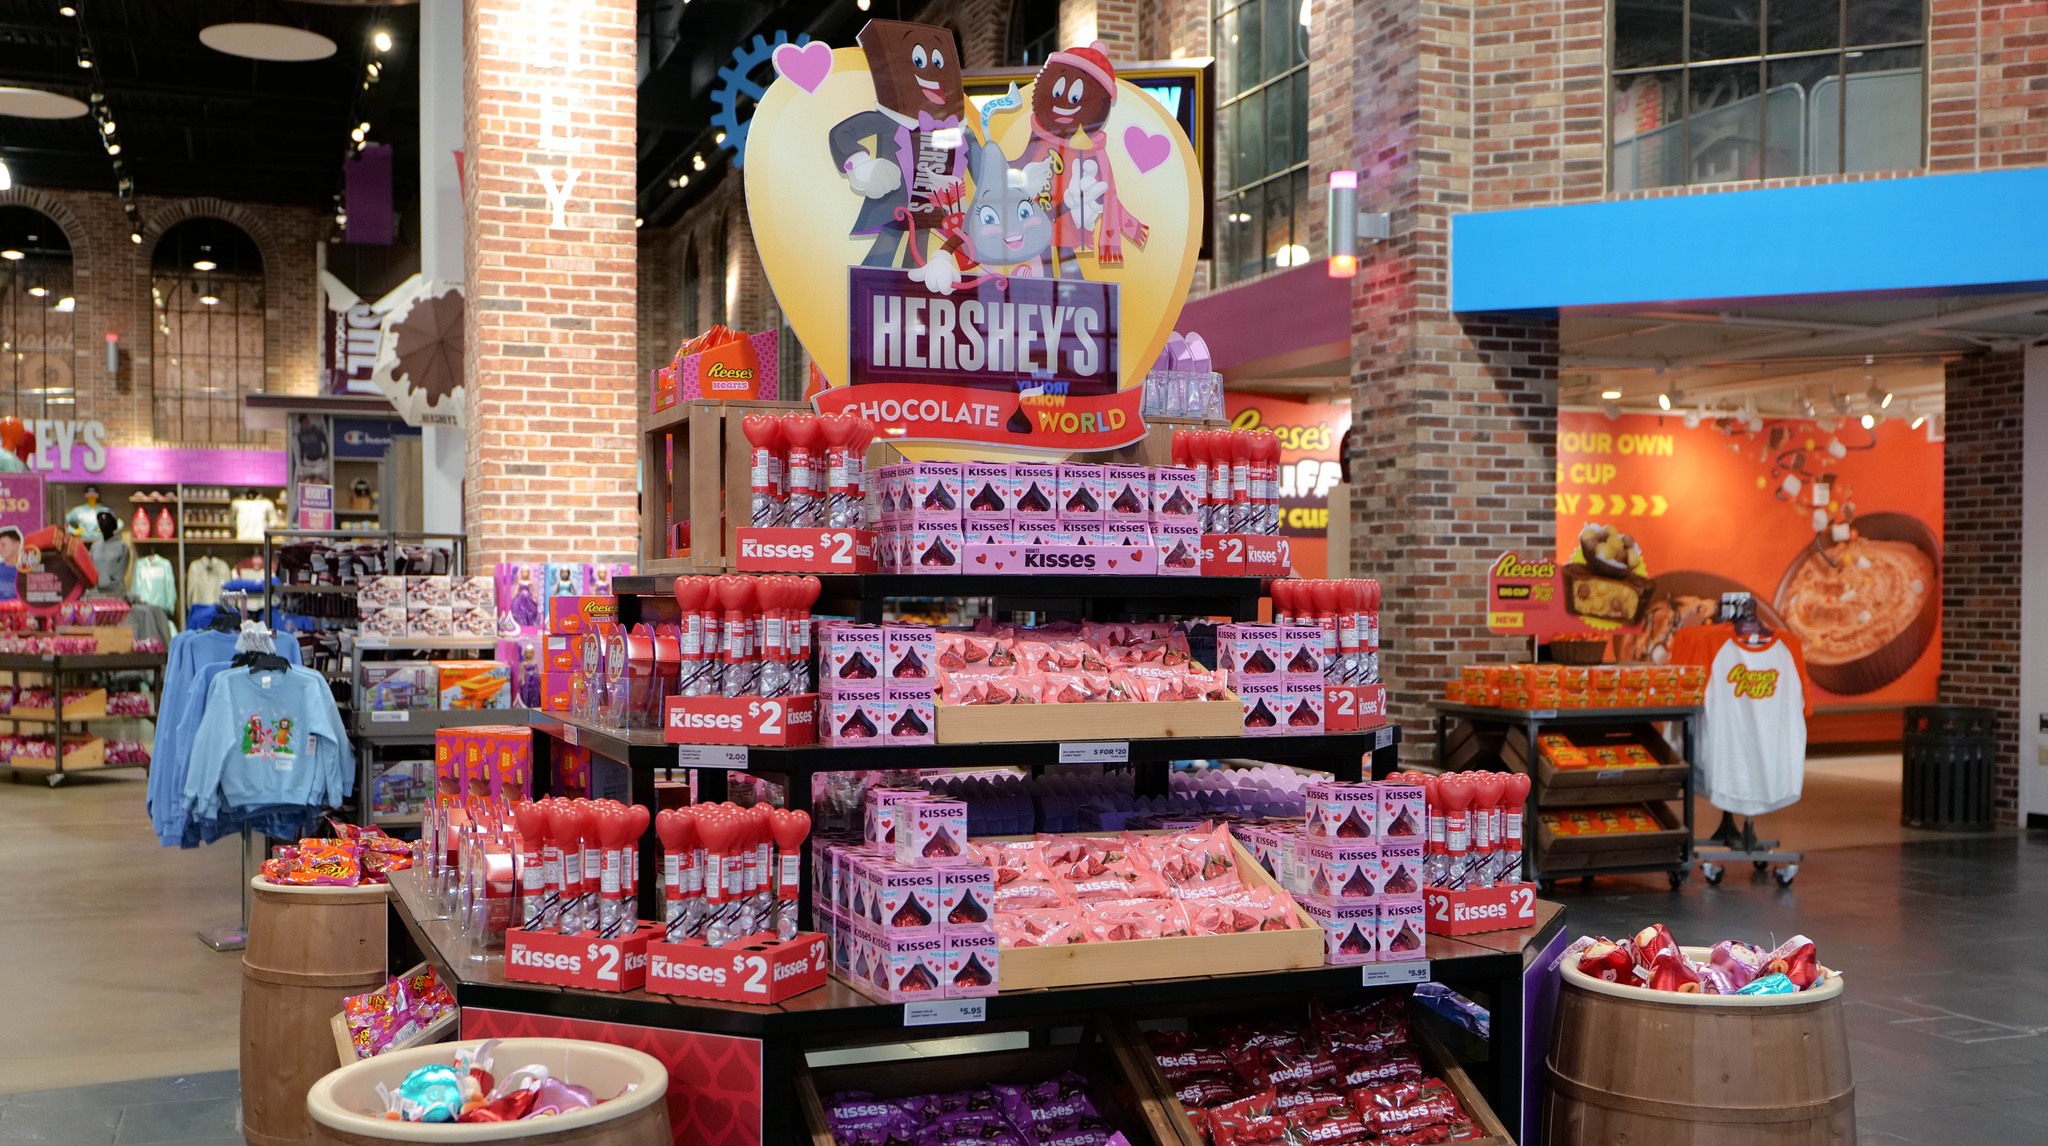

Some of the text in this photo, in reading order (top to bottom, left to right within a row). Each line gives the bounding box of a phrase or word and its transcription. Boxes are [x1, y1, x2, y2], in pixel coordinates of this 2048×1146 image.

[873, 296, 1099, 376] HERSHEY'S
[707, 362, 754, 379] Reese's
[1038, 408, 1126, 434] WORLD
[1617, 434, 1674, 456] OWN
[1570, 463, 1616, 484] CUP
[820, 533, 853, 564] $2
[1219, 538, 1243, 563] $2
[1277, 540, 1291, 568] $2
[1495, 554, 1556, 579] Reese's
[1495, 616, 1518, 624] NEW
[1329, 690, 1355, 715] $2
[748, 701, 782, 734] $2
[1429, 894, 1449, 921] $2
[1510, 888, 1534, 918] $2
[587, 943, 620, 981] $2
[810, 940, 826, 971] $2
[733, 955, 768, 993] $2
[960, 1007, 982, 1015] $5.95
